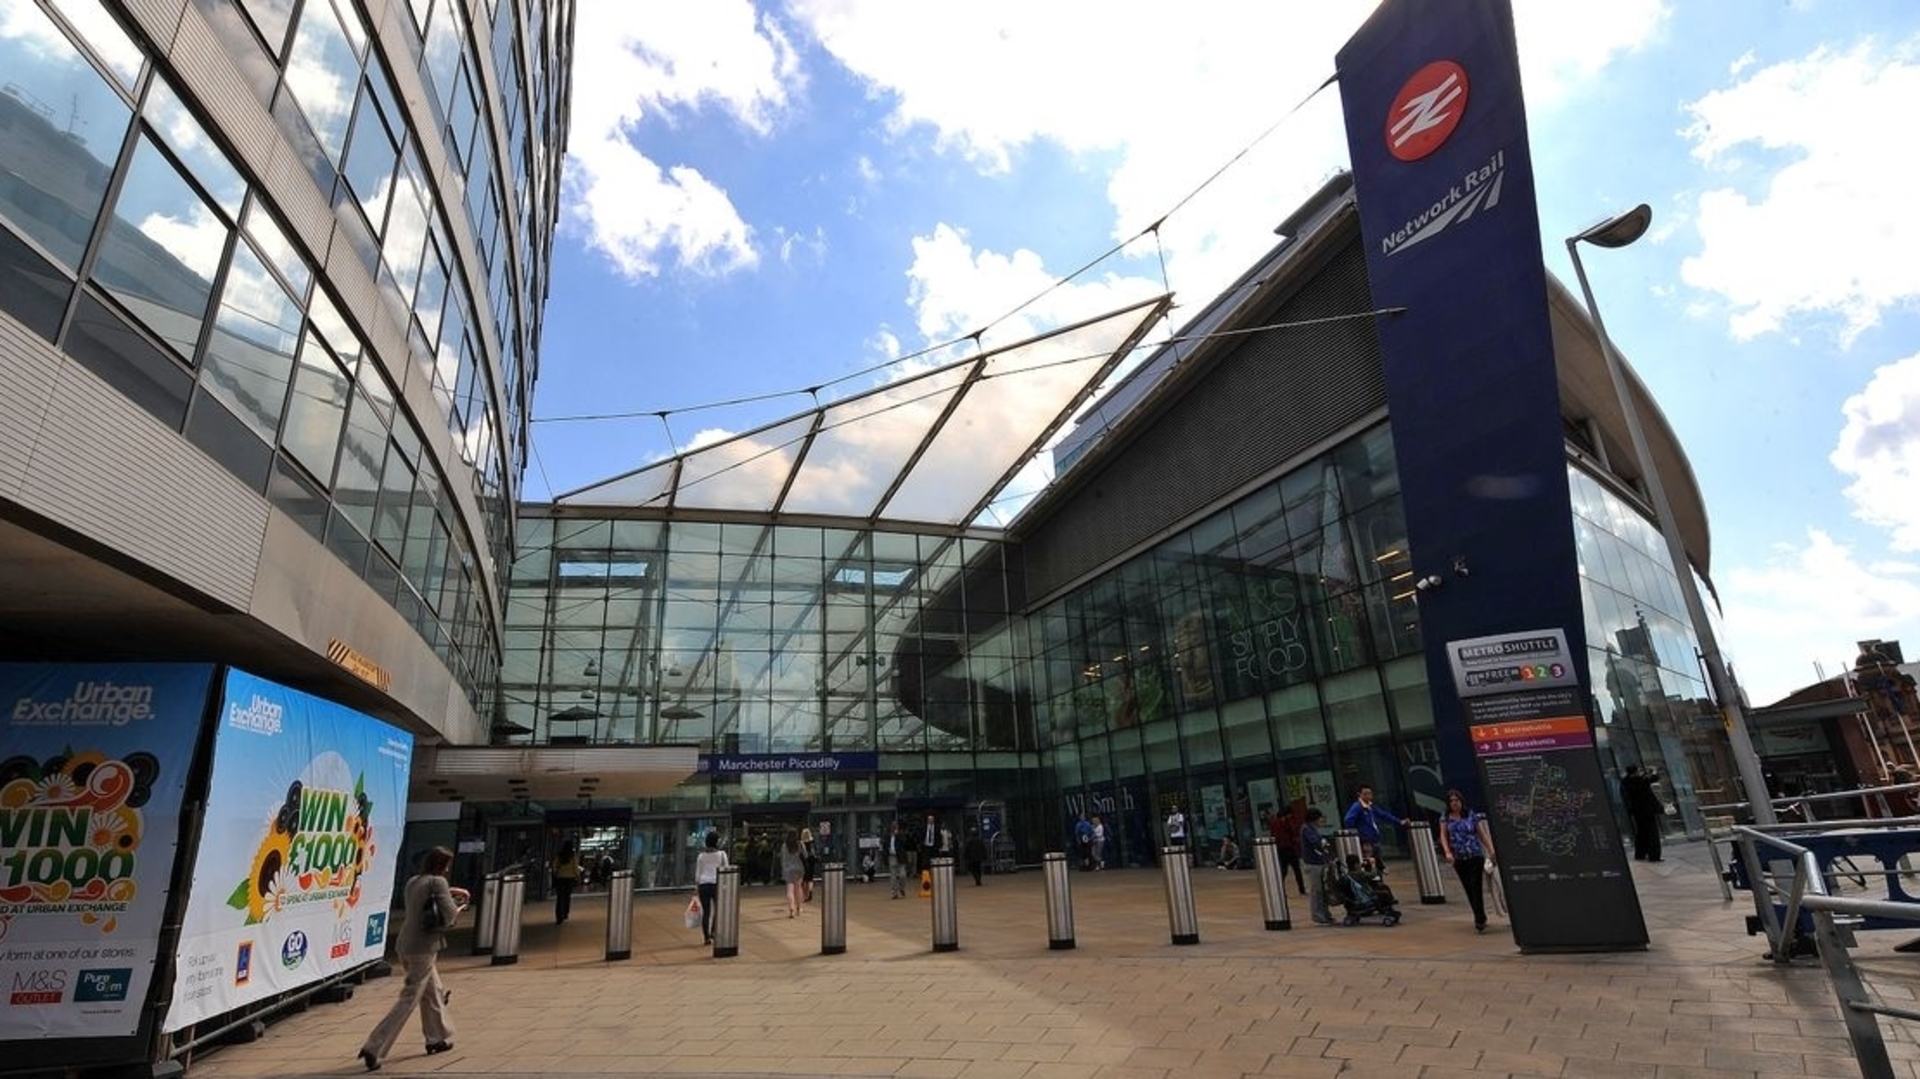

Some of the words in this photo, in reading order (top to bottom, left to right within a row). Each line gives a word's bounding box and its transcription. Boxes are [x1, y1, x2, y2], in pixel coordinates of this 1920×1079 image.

[1383, 187, 1462, 253] Network
[1465, 150, 1504, 192] Rail
[1231, 612, 1301, 656] SIPLY
[1462, 639, 1555, 658] METROSHUTTLE
[1523, 667, 1535, 679] 1
[1537, 667, 1547, 678] 2
[1554, 666, 1563, 677] 3
[74, 682, 153, 703] Urban
[13, 698, 156, 726] Exchange.
[252, 694, 282, 720] Urban
[719, 758, 785, 771] Manchester
[788, 757, 841, 770] Piccadilly
[301, 787, 348, 832] WIN
[289, 832, 357, 876] £1000
[0, 849, 135, 889] 1000
[8, 905, 24, 914] AT
[27, 904, 65, 913] URBAN
[67, 903, 127, 912] EXCHANGE
[6, 949, 31, 961] form
[33, 950, 44, 961] at
[46, 951, 66, 960] one
[69, 949, 79, 960] of
[81, 950, 98, 960] our
[12, 969, 67, 992] M&S
[84, 973, 110, 983] Pure
